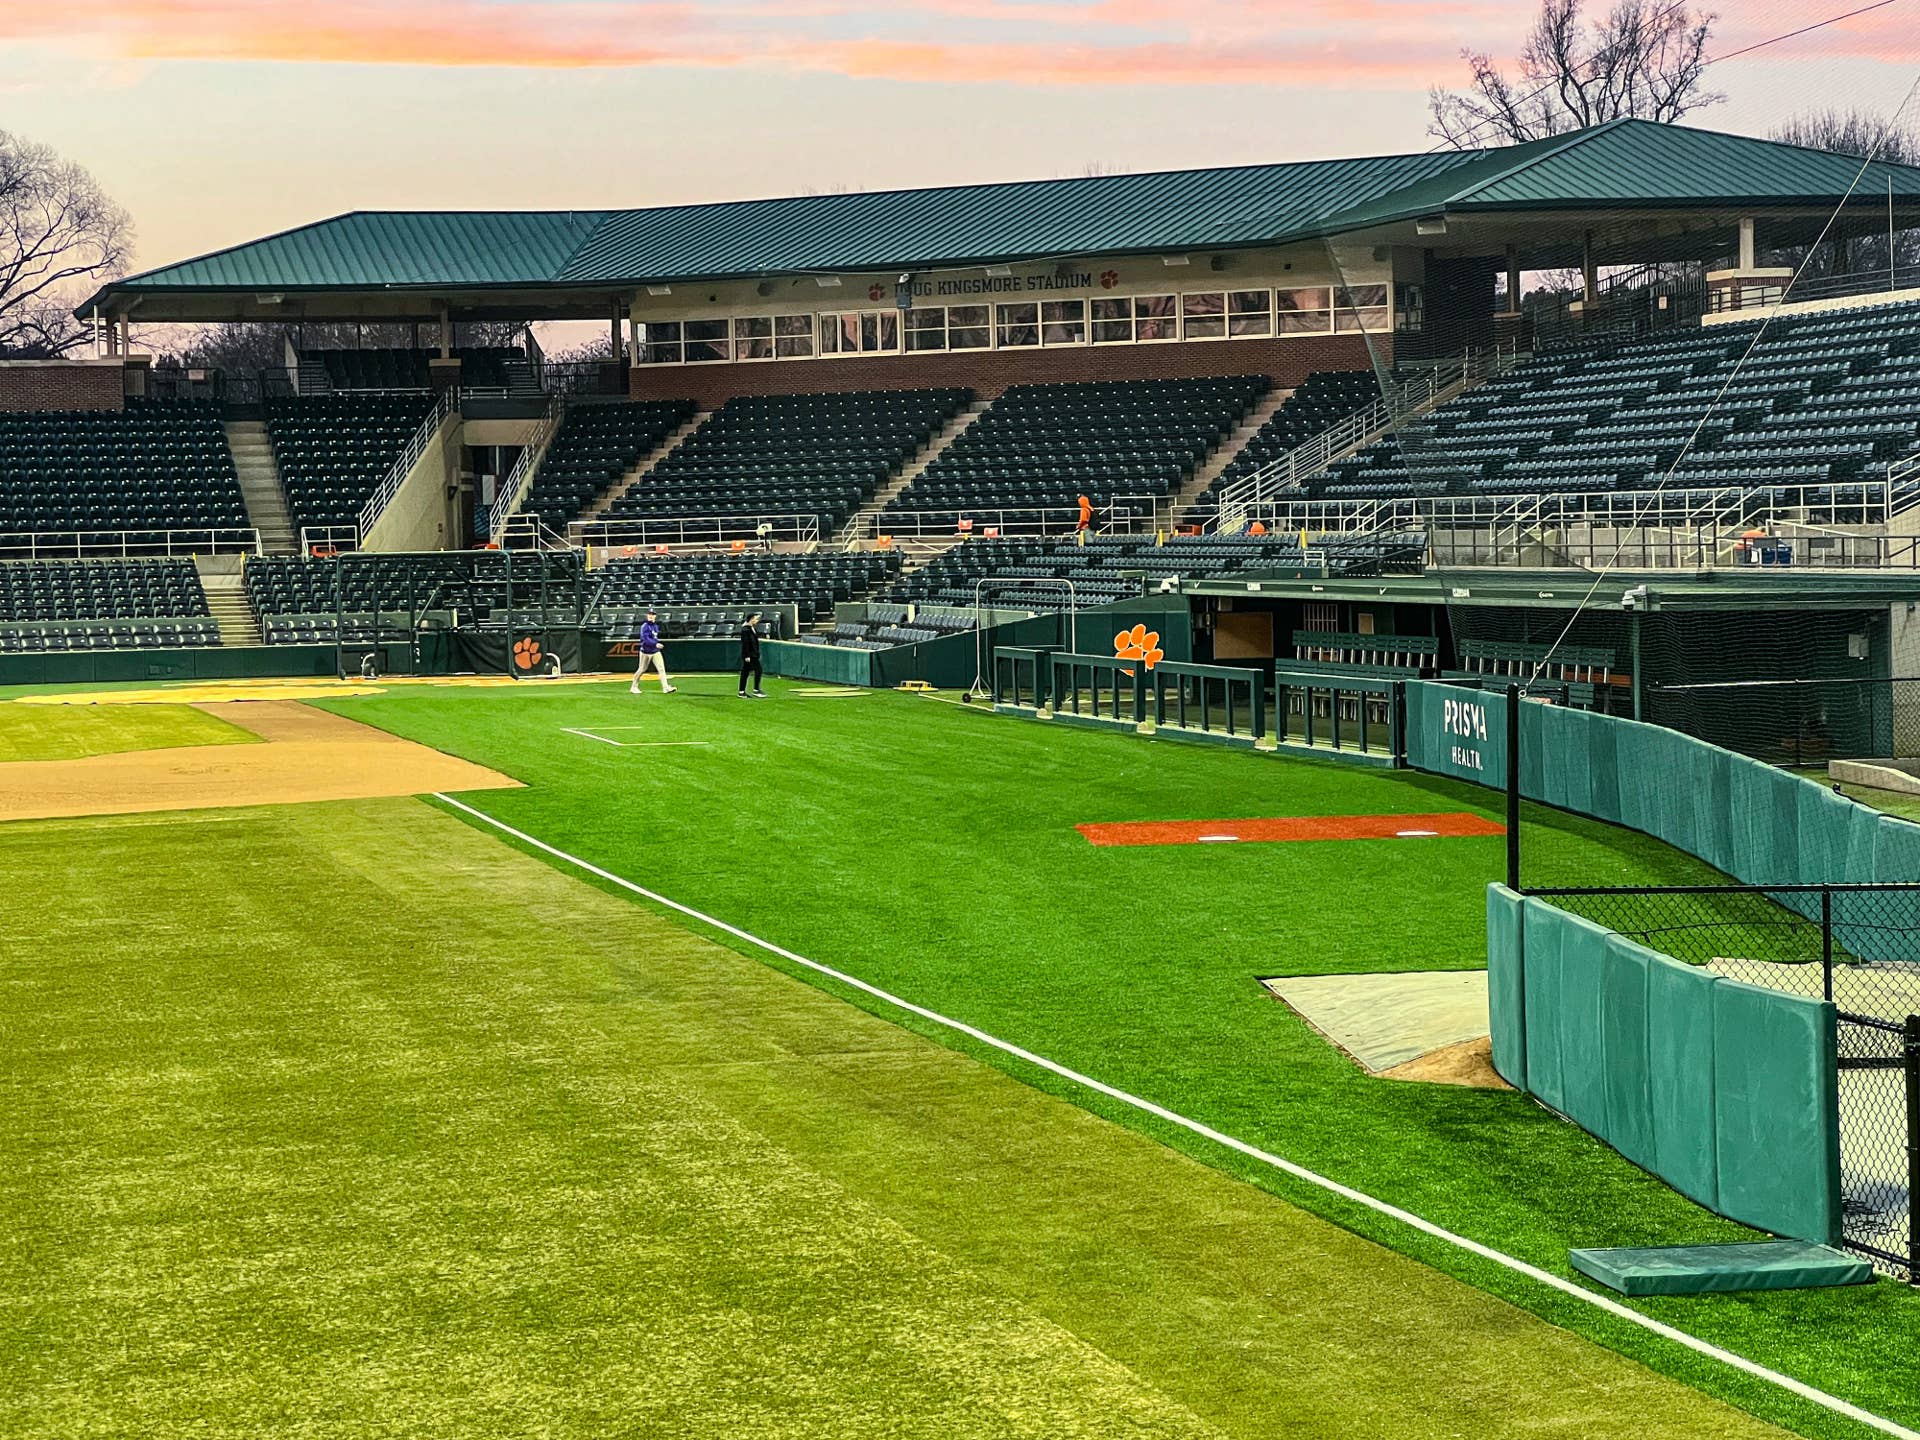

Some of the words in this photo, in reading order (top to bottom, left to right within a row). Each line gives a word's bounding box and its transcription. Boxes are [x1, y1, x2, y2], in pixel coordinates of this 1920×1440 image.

[938, 275, 1022, 295] KINGSMORE
[1027, 272, 1092, 290] STADIUM
[1444, 699, 1488, 742] PRISMA
